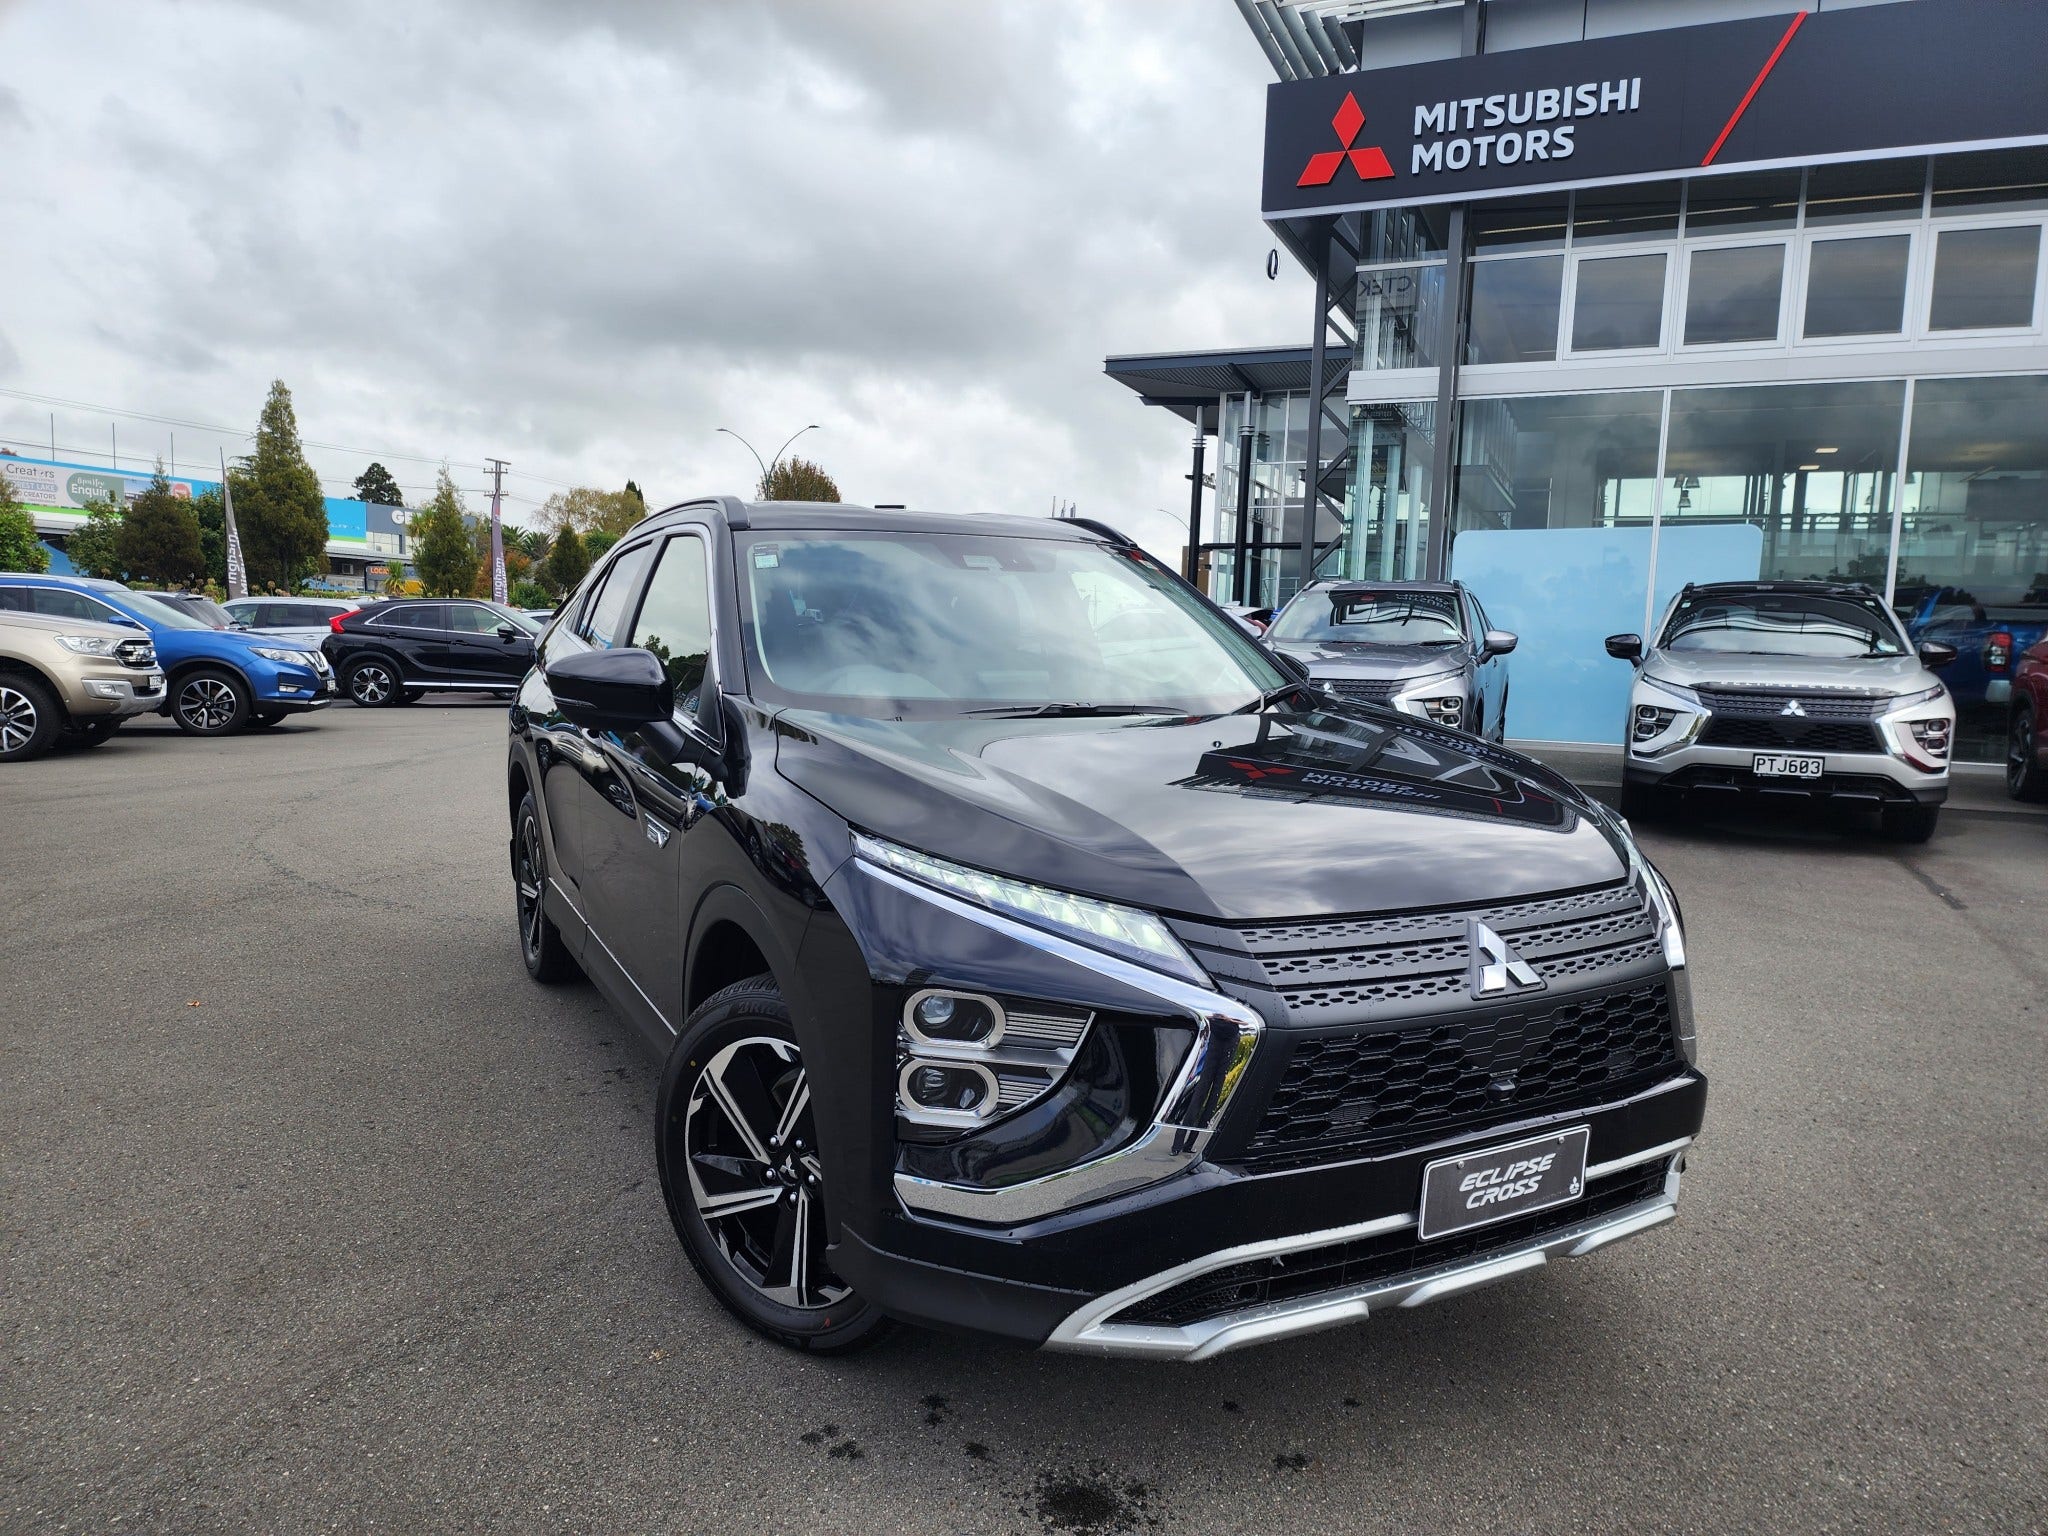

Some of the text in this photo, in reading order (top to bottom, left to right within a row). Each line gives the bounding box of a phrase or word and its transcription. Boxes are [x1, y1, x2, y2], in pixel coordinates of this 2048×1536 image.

[1413, 77, 1642, 136] MITSUBISHI
[1411, 125, 1575, 175] MOTORS
[494, 557, 503, 597] Ingham
[1756, 758, 1821, 774] PTJ603
[1459, 1152, 1556, 1192] ECLIPSE
[1465, 1175, 1543, 1210] CROSS
